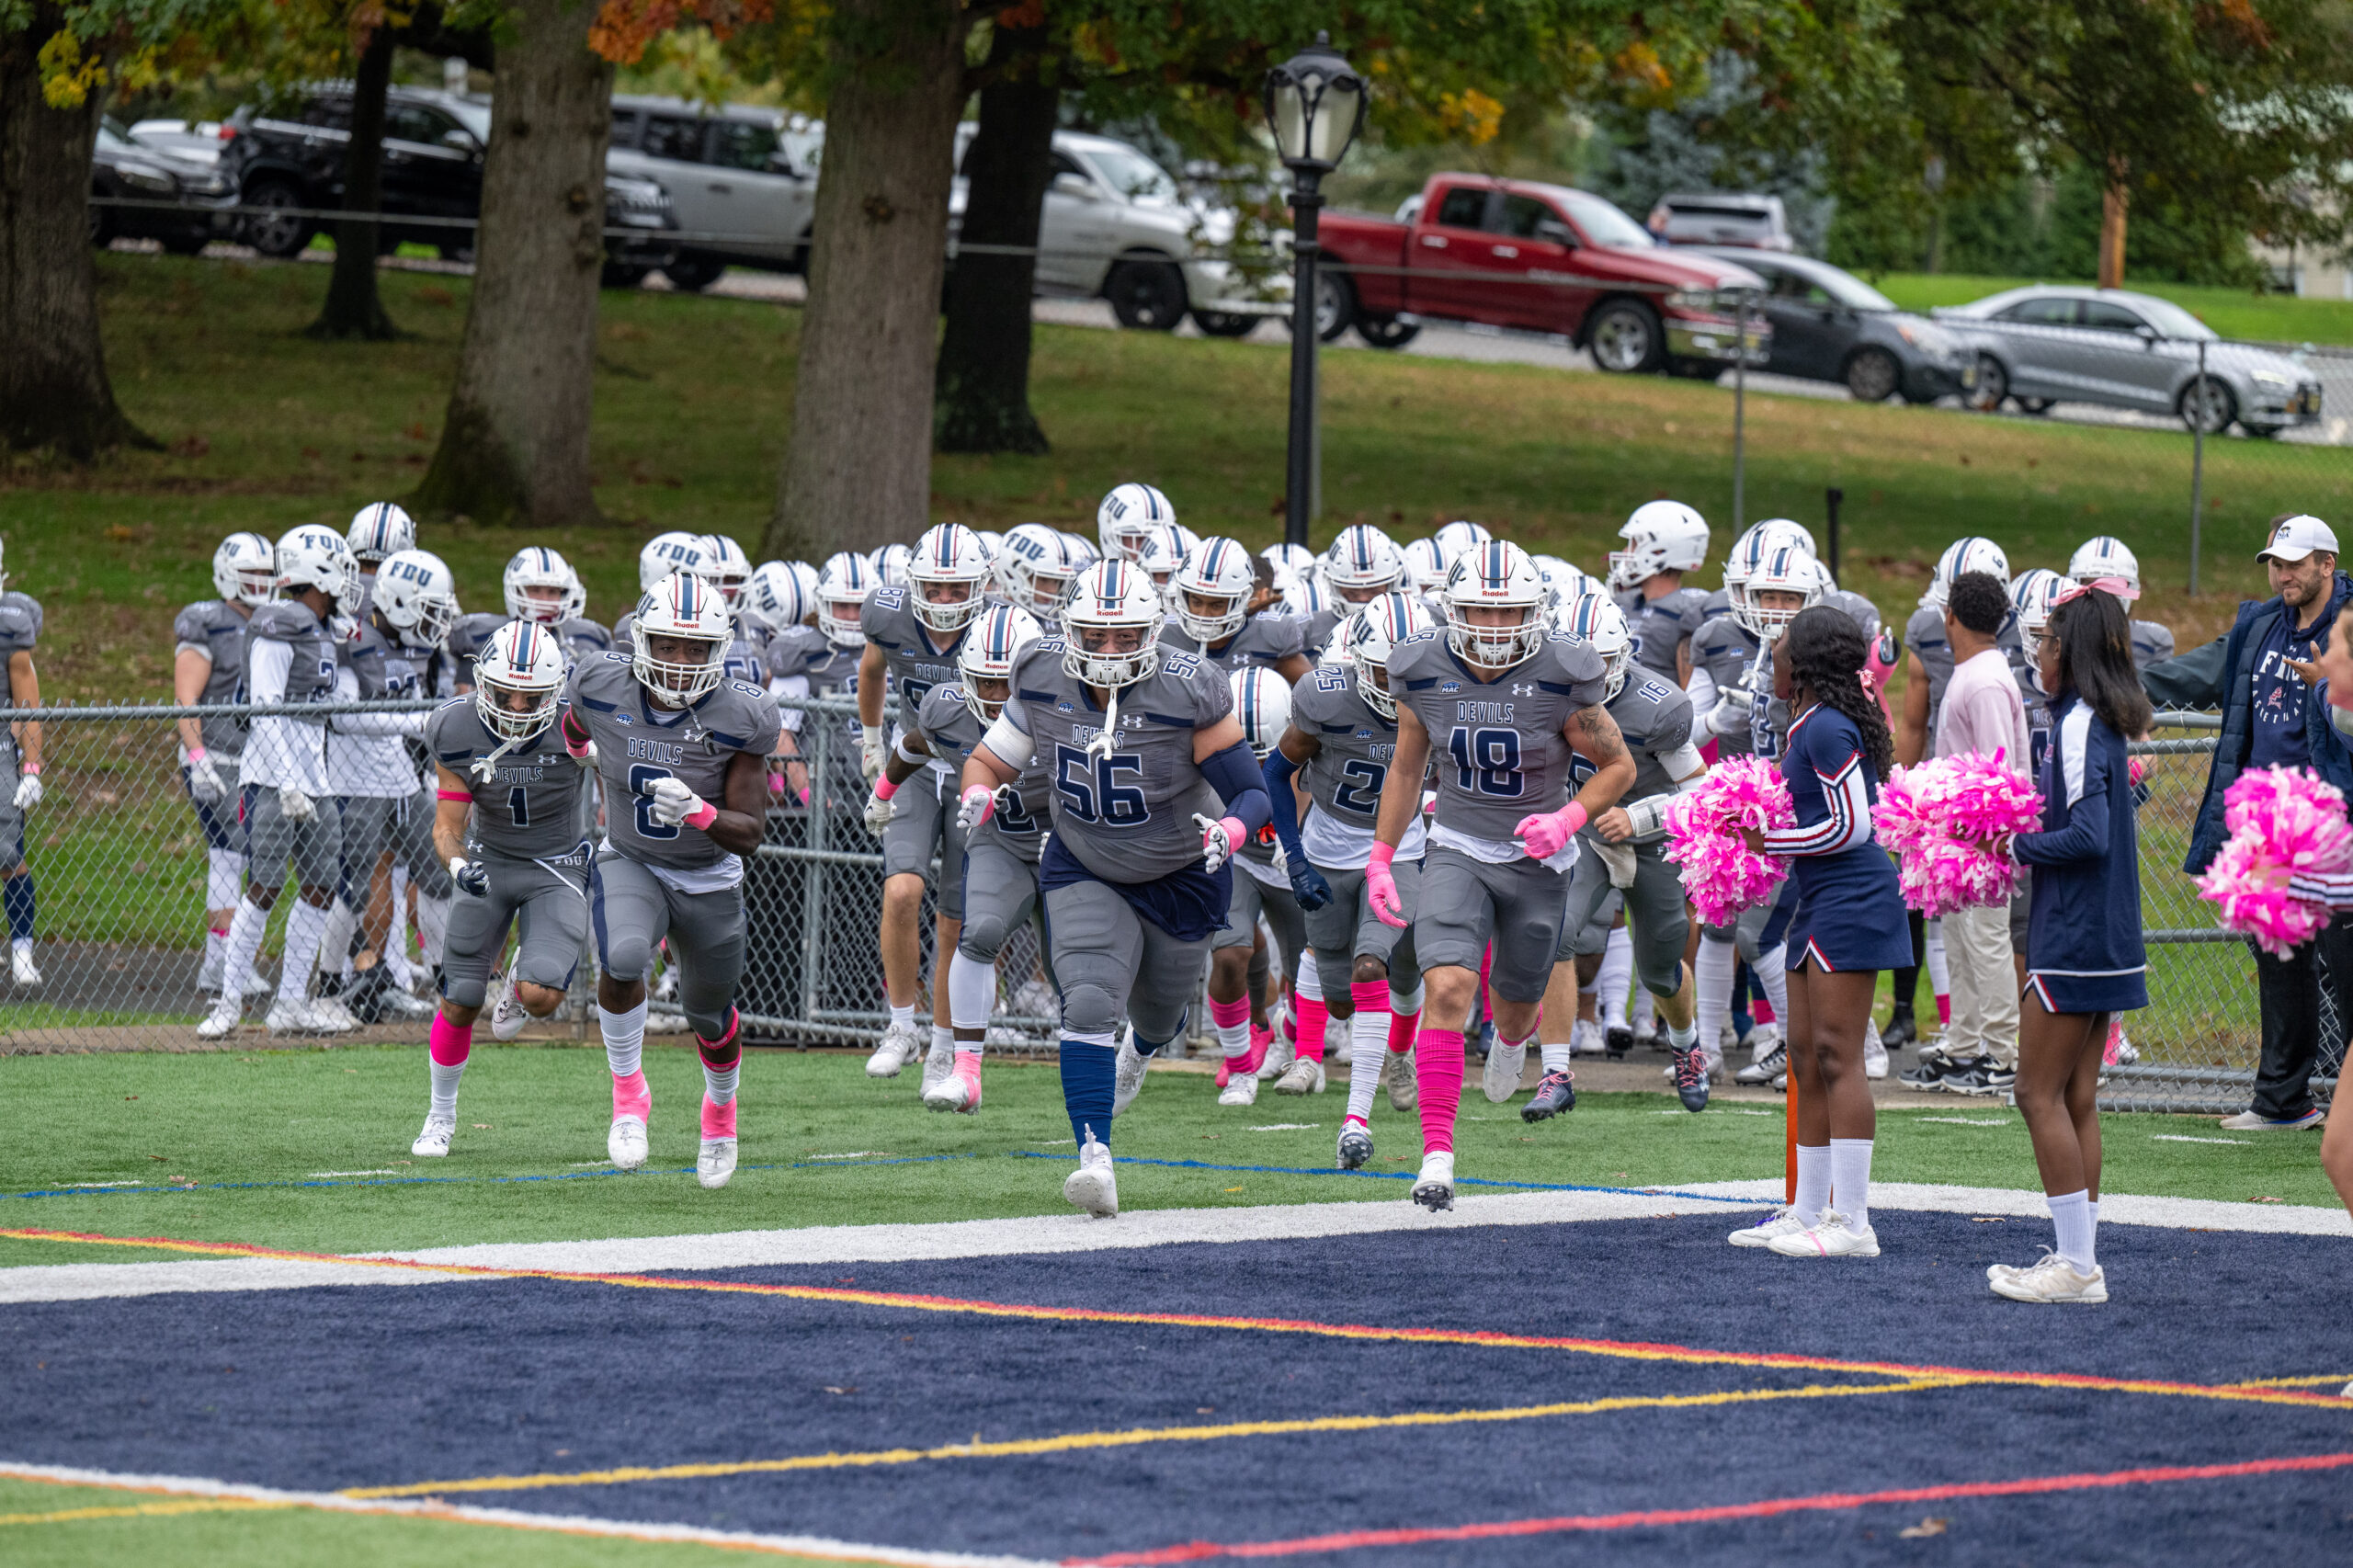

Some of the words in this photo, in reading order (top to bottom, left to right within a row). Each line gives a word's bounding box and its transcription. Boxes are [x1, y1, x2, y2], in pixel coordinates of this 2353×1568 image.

[656, 541, 701, 566] FDU
[1006, 532, 1046, 561] FDU
[388, 561, 433, 587] FDU
[875, 586, 905, 611] 87
[1482, 589, 1508, 597] Riddell
[1097, 608, 1123, 617] Riddell
[673, 621, 699, 630] Riddell
[603, 651, 634, 665] 8
[1163, 649, 1203, 680] 56
[508, 672, 533, 681] Riddell
[1313, 666, 1347, 693] 25
[731, 681, 763, 699] 8
[1637, 679, 1672, 705] 16
[615, 716, 633, 727] MAC
[1057, 706, 1074, 714] MAC
[1457, 700, 1514, 723] DEVILS
[1072, 724, 1125, 750] DES
[628, 736, 683, 766] DEVILS
[1448, 725, 1526, 798] 18
[493, 766, 544, 783] DEVILS
[1055, 742, 1152, 827] 56
[506, 786, 529, 827] 1
[628, 762, 681, 841] 8
